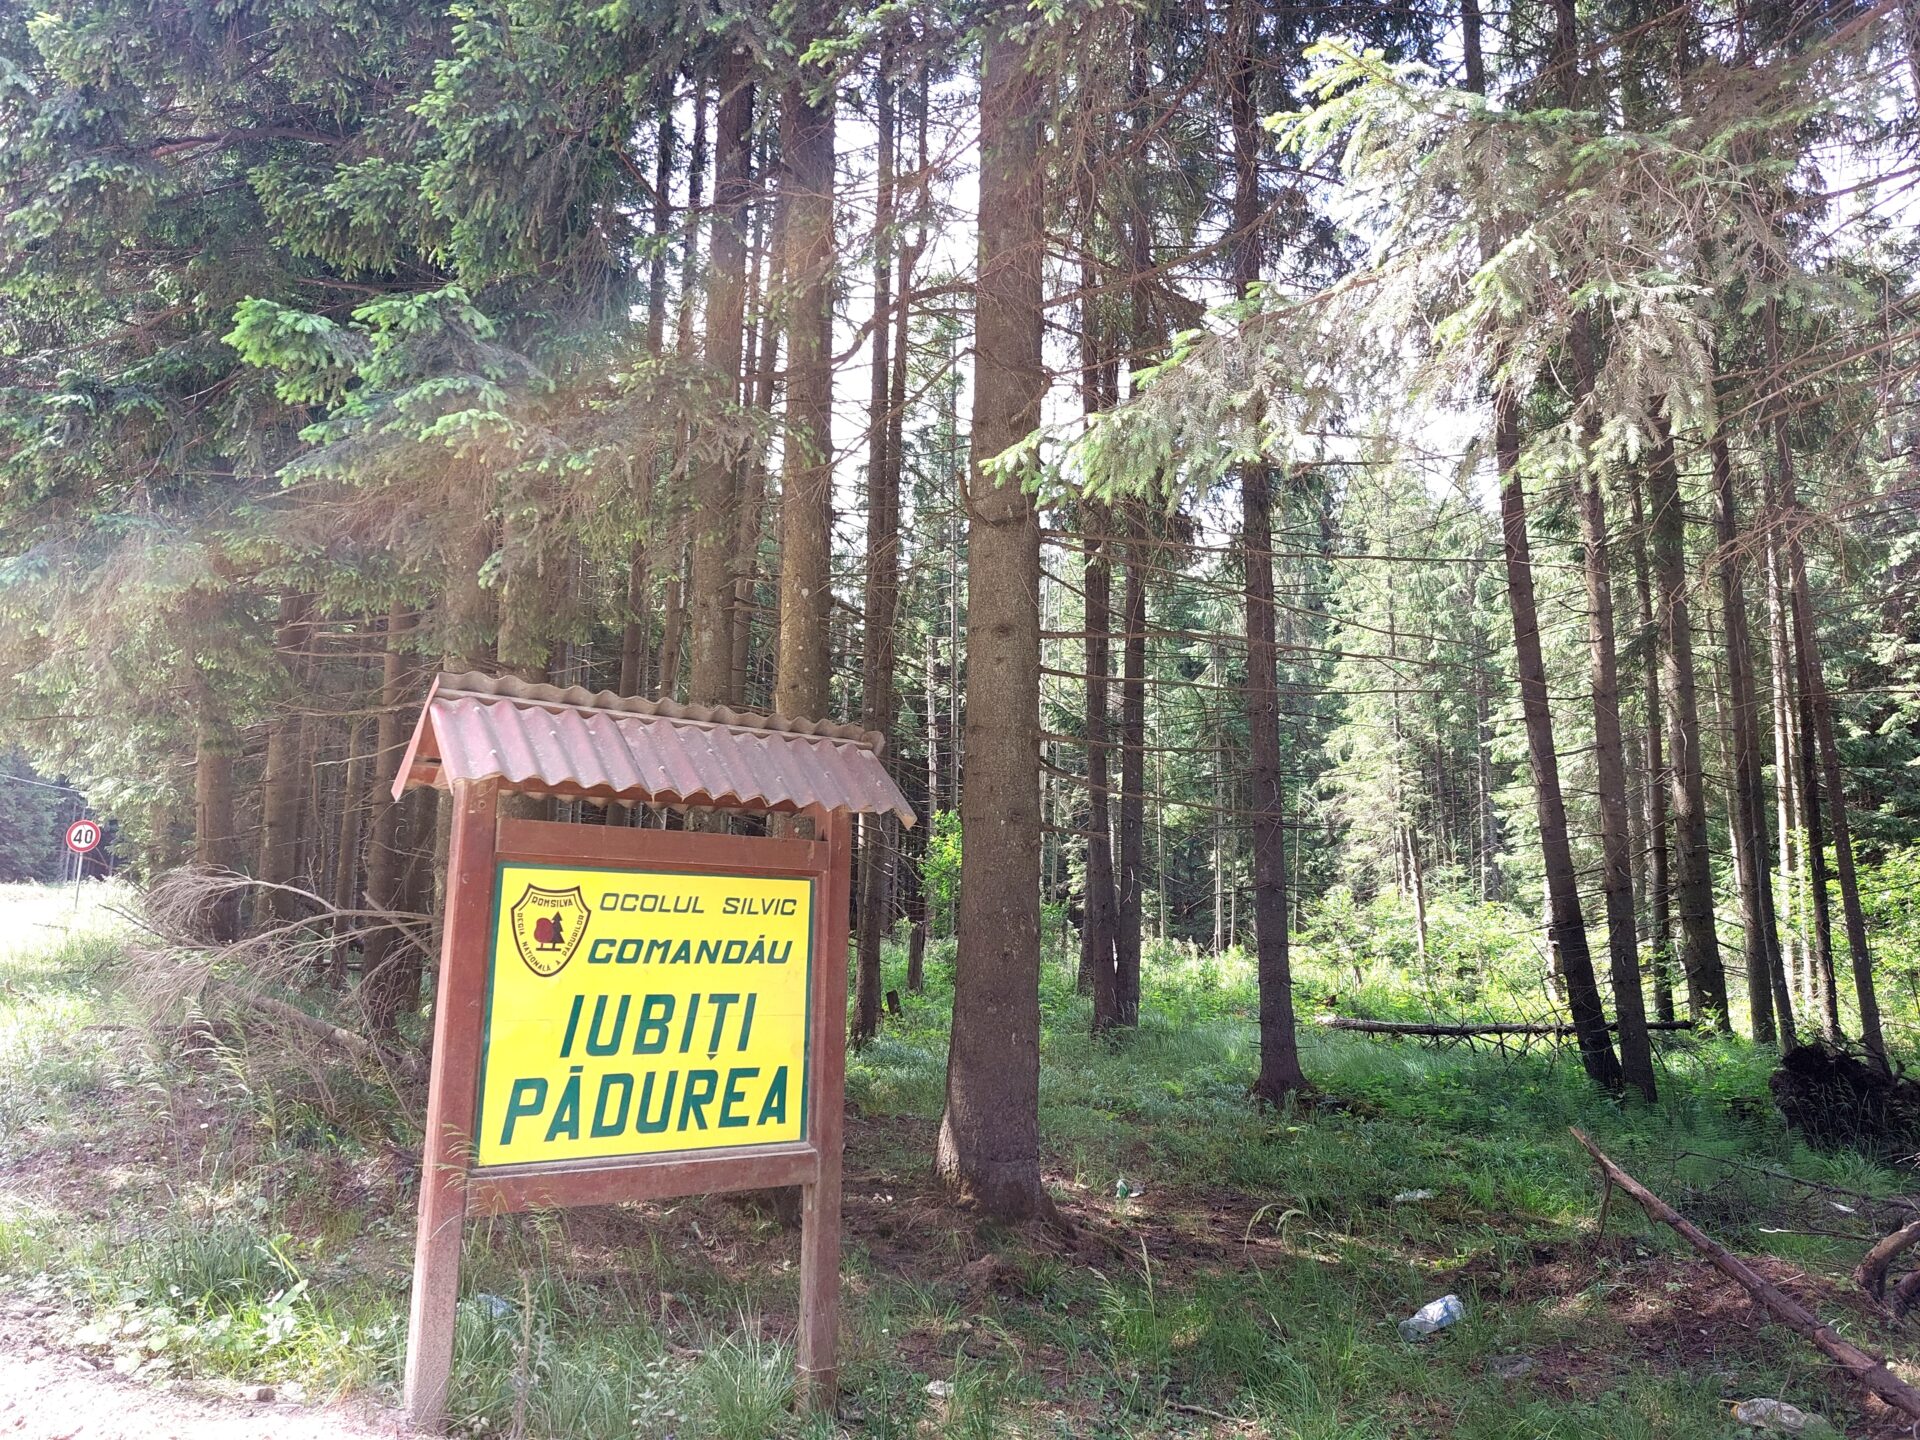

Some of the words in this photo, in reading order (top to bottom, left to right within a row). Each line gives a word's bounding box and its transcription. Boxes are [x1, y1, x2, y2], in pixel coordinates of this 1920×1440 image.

[73, 829, 93, 844] 40
[531, 896, 573, 908] ROMSILVA
[599, 892, 706, 914] OCOLUL
[722, 897, 798, 916] SILVIC
